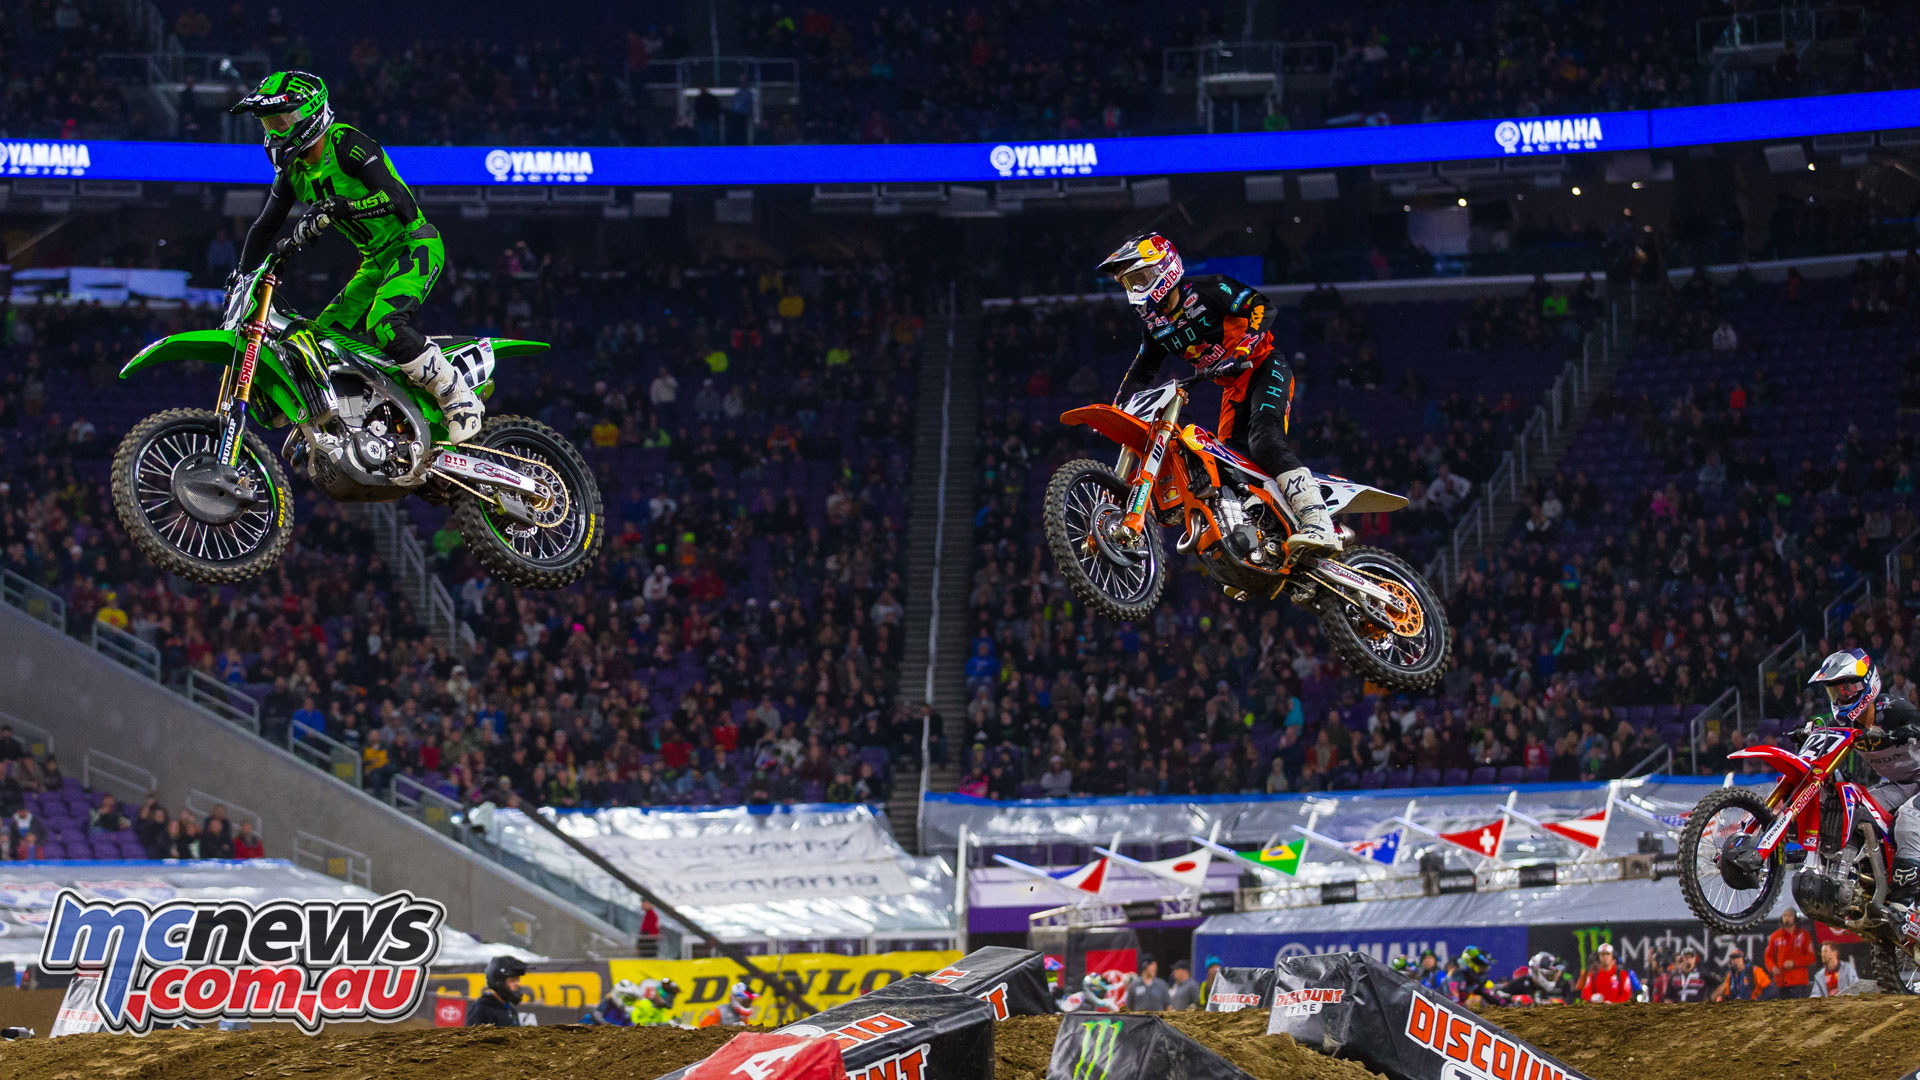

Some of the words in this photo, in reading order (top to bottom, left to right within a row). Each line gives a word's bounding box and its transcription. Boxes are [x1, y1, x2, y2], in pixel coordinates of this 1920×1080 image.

[1519, 117, 1602, 144] YAMAHA
[7, 142, 90, 168] YAMAHA
[510, 151, 593, 174] YAMAHA
[1014, 143, 1098, 168] YAMAHA
[354, 190, 390, 210] UST1
[240, 341, 258, 385] SHOWA
[221, 418, 236, 464] DUNLOP
[1795, 783, 1817, 811] SHOWA
[1766, 815, 1787, 842] DUNLOP
[1275, 988, 1344, 1007] DISCOUNT
[1289, 1003, 1316, 1014] TIRE
